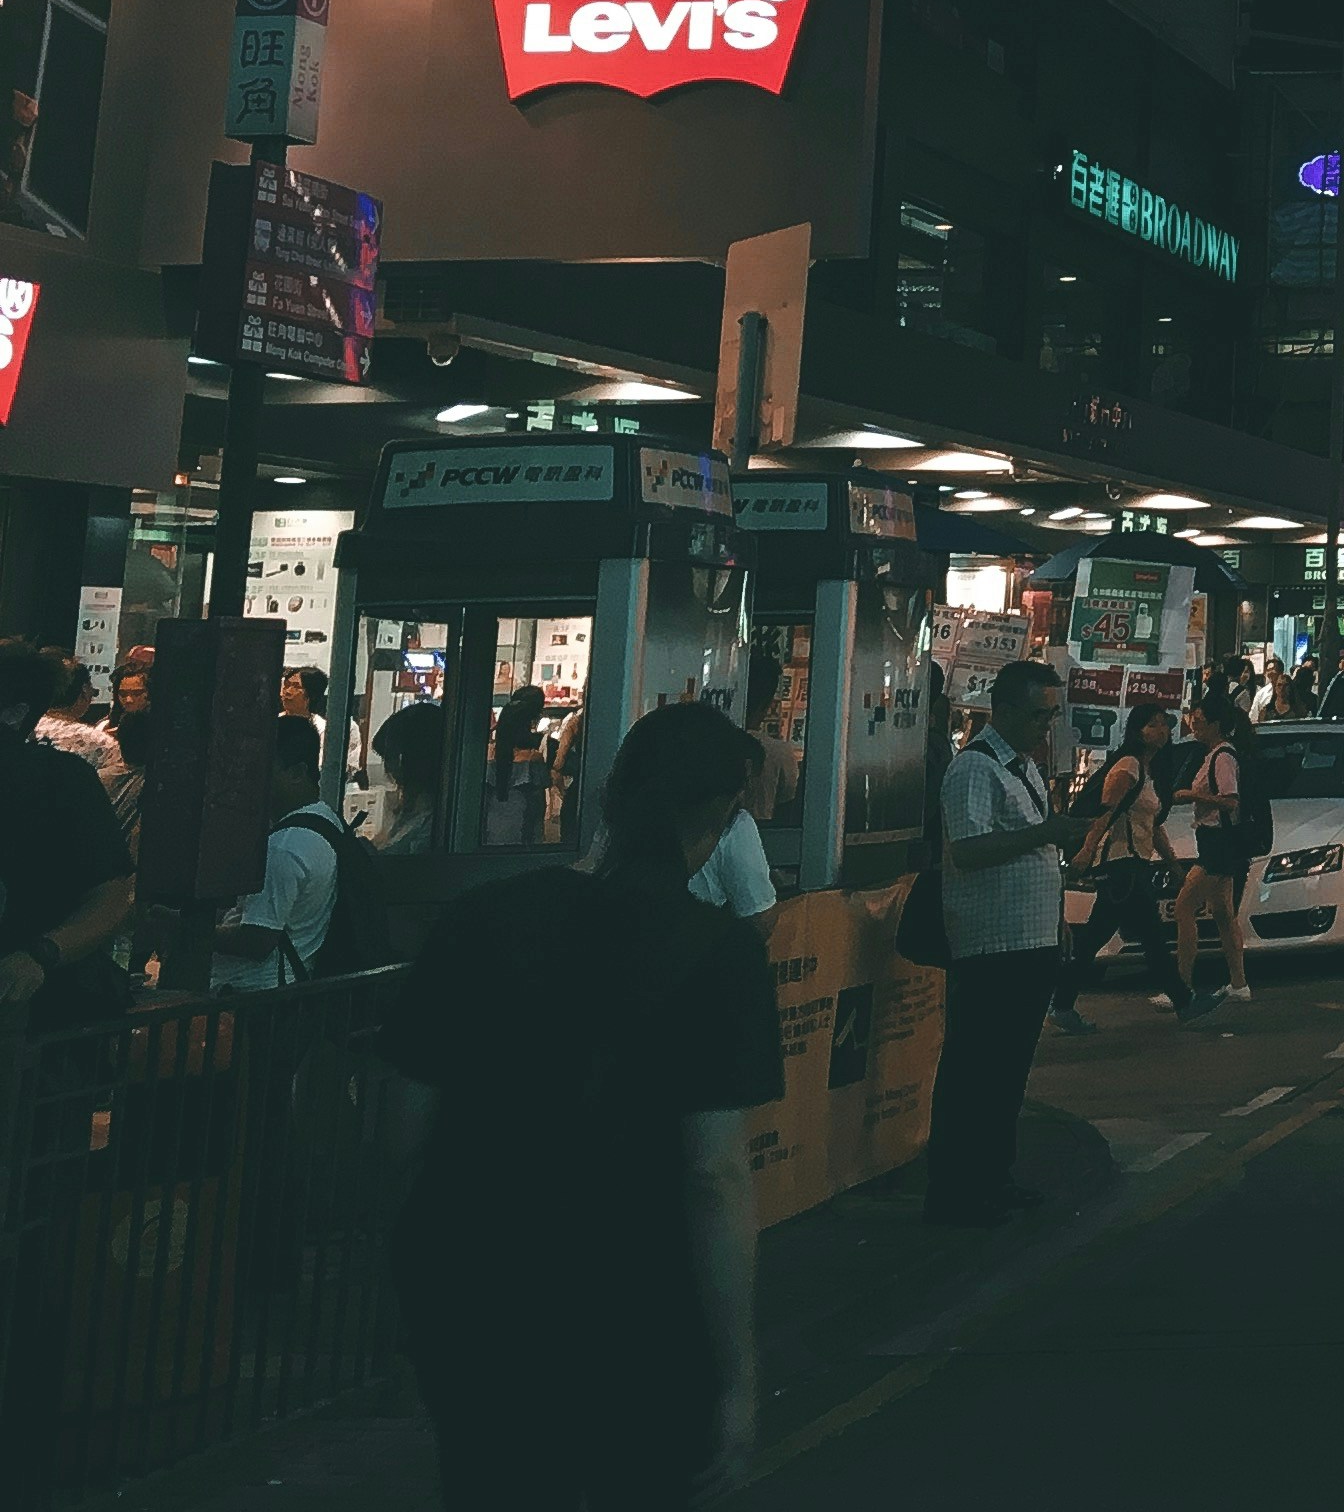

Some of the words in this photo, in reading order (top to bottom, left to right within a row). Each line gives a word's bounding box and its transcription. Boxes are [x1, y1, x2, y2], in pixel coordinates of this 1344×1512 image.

[234, 29, 286, 124] 旺角
[1140, 187, 1240, 283] BROADWAY
[439, 464, 522, 488] PCCW
[1080, 611, 1132, 642] $45
